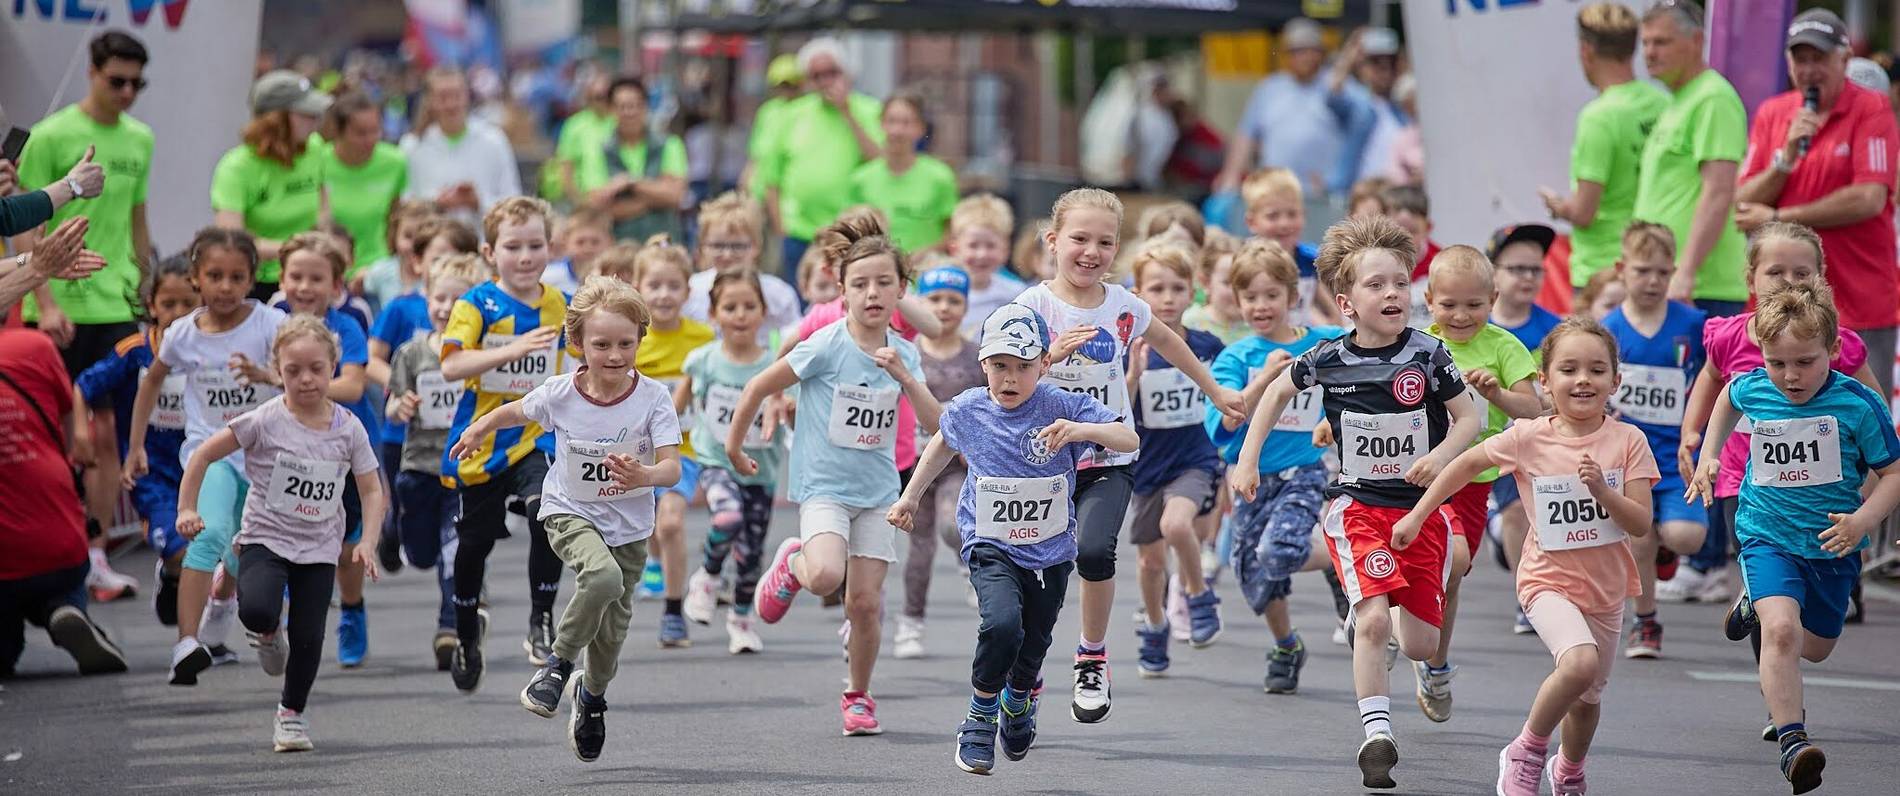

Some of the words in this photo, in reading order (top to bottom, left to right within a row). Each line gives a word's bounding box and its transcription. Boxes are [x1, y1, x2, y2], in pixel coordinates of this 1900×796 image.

[207, 384, 256, 407] 2052
[1152, 387, 1206, 412] 2574
[1620, 385, 1676, 408] 2566
[845, 406, 895, 429] 2013
[857, 434, 881, 445] AGIS
[1355, 434, 1416, 458] 2004
[1762, 440, 1820, 465] 2041
[1371, 463, 1401, 474] AGIS
[1779, 469, 1809, 481] AGIS
[284, 476, 335, 501] 2033
[295, 503, 320, 516] AGIS
[992, 498, 1053, 522] 2027
[1548, 498, 1609, 525] 2050
[1008, 528, 1039, 539] AGIS
[1566, 529, 1598, 542] AGIS
